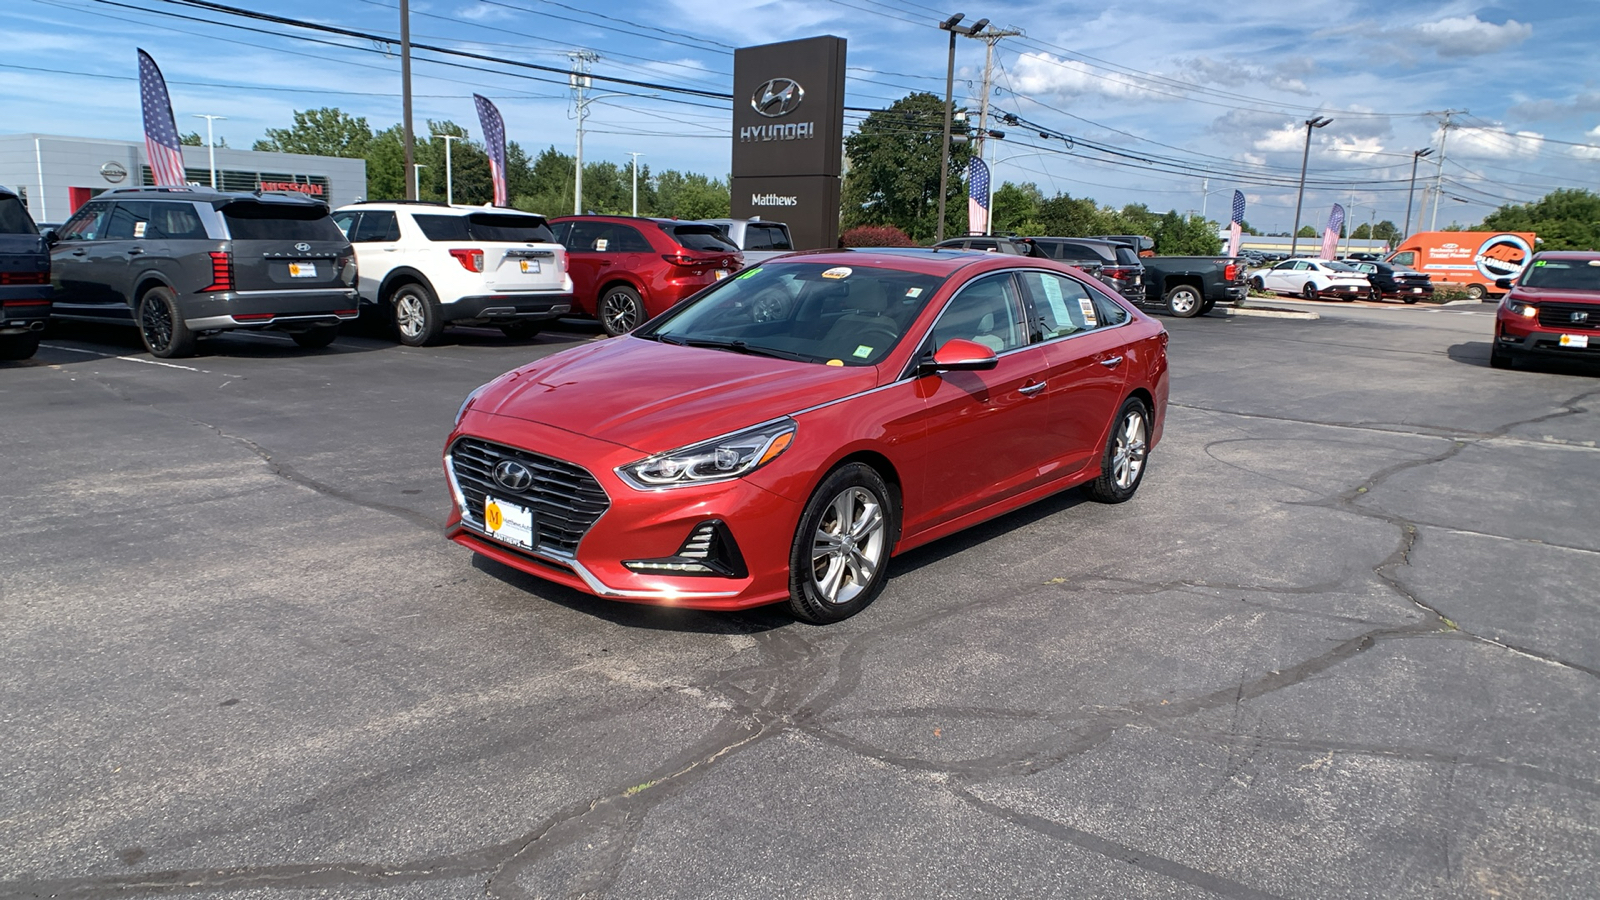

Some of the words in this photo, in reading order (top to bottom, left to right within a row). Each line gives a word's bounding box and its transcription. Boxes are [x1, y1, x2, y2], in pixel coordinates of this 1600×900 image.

[740, 122, 814, 142] HYUNDAI
[260, 181, 323, 195] NISSAN
[751, 193, 798, 206] Matthews
[489, 510, 499, 525] M
